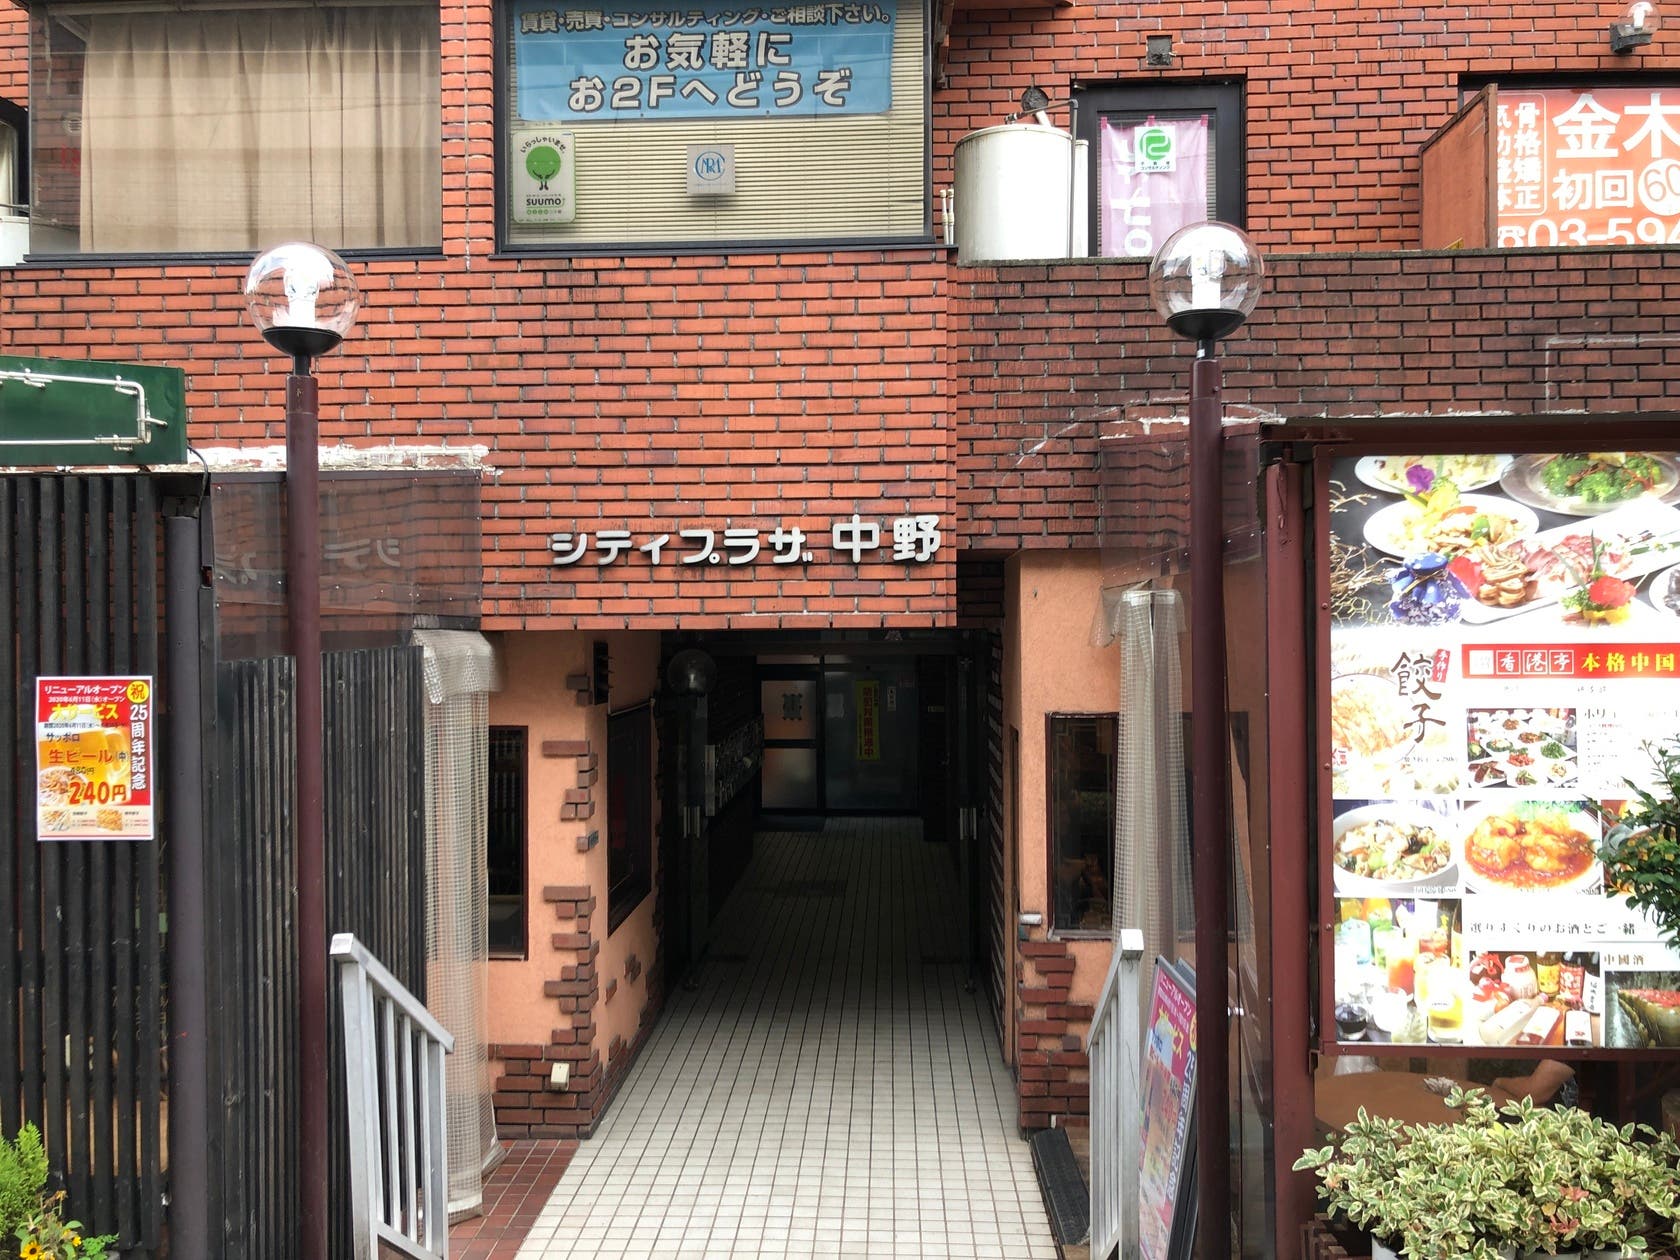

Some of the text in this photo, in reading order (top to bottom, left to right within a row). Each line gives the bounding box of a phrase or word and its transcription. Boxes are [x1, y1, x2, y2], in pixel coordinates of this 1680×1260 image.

[623, 31, 793, 71] お気軽に
[568, 67, 853, 113] お2Fへどうぞ
[1551, 92, 1680, 160] 金木
[1551, 168, 1634, 210] 初回
[551, 513, 942, 566] シティプラザ中野
[1498, 652, 1571, 673] 香港亭
[1581, 652, 1675, 673] 本格中国
[44, 685, 127, 694] リニューアルオープン
[131, 684, 145, 700] 祝
[1391, 651, 1446, 743] 餃子
[46, 732, 80, 743] サッポロ
[130, 704, 148, 790] 25周年記念
[69, 781, 127, 805] 240円
